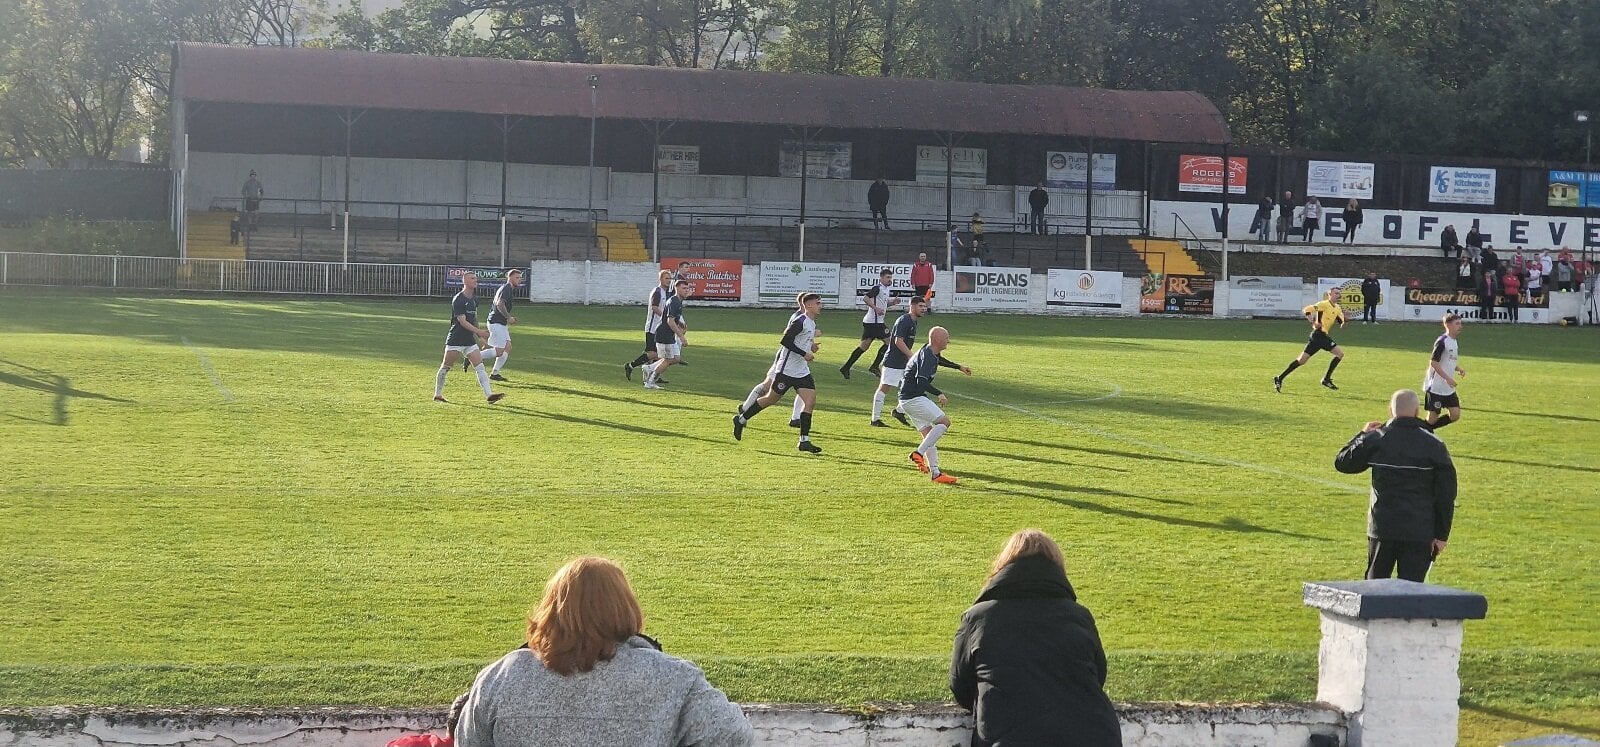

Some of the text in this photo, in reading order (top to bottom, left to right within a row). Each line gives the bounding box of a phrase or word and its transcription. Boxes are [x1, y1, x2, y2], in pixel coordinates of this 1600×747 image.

[1454, 170, 1491, 179] Bathrooms
[1454, 179, 1482, 187] Kitchens
[1211, 207, 1347, 237] VE
[1384, 214, 1438, 241] OF
[474, 270, 497, 278] HUWS
[707, 269, 739, 281] Butchers
[804, 265, 837, 274] Landscapes
[860, 277, 911, 288] BUIERS
[976, 272, 1028, 287] DEANS
[976, 286, 1028, 296] CIVIL ENGINEERING
[1168, 277, 1195, 295] RR
[1053, 287, 1066, 300] kg
[1345, 294, 1361, 303] 10
[1409, 288, 1454, 305] Cheaper
